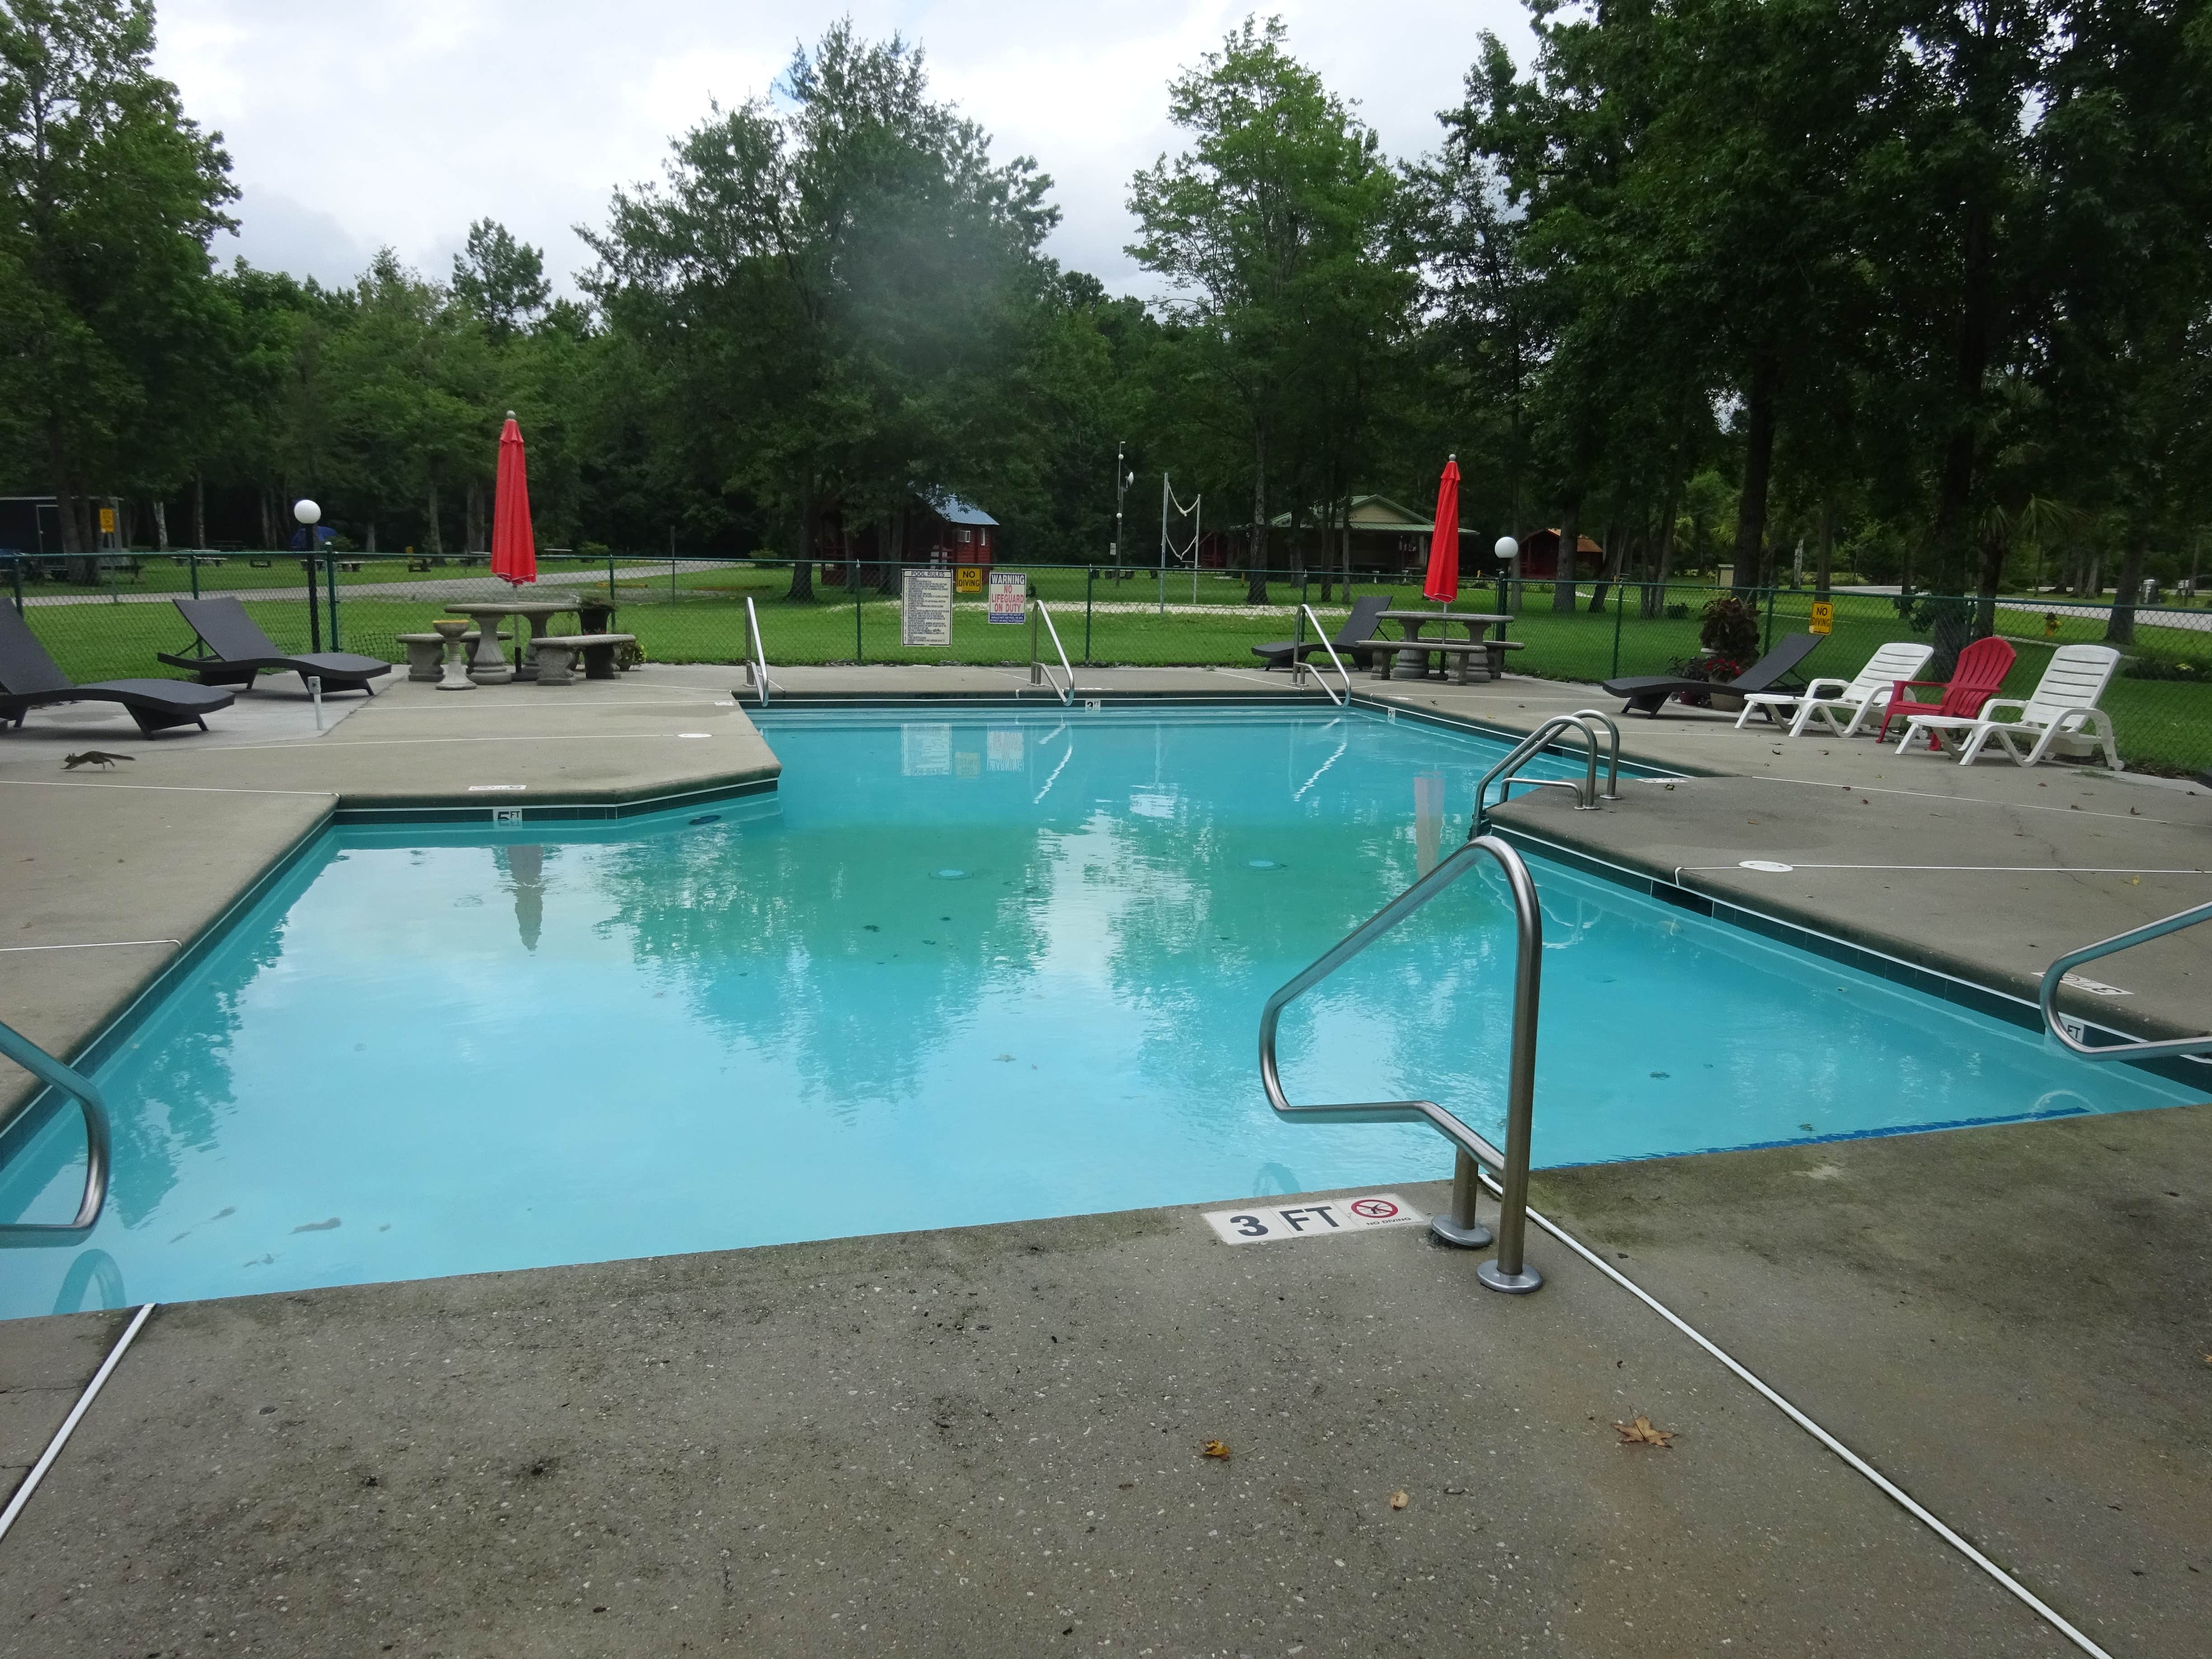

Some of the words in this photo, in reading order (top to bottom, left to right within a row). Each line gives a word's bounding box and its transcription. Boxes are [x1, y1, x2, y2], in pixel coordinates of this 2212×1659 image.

[991, 574, 1025, 585] WARNING
[1004, 585, 1012, 594] NO
[991, 594, 1024, 603] LIFEGUARD
[994, 604, 1003, 612] ON
[1006, 604, 1021, 613] DUTY
[1816, 607, 1828, 616] NO
[1811, 617, 1830, 627] DIVING
[2067, 1024, 2081, 1038] FT
[1229, 1215, 1269, 1237] 3
[1279, 1206, 1340, 1231] FT
